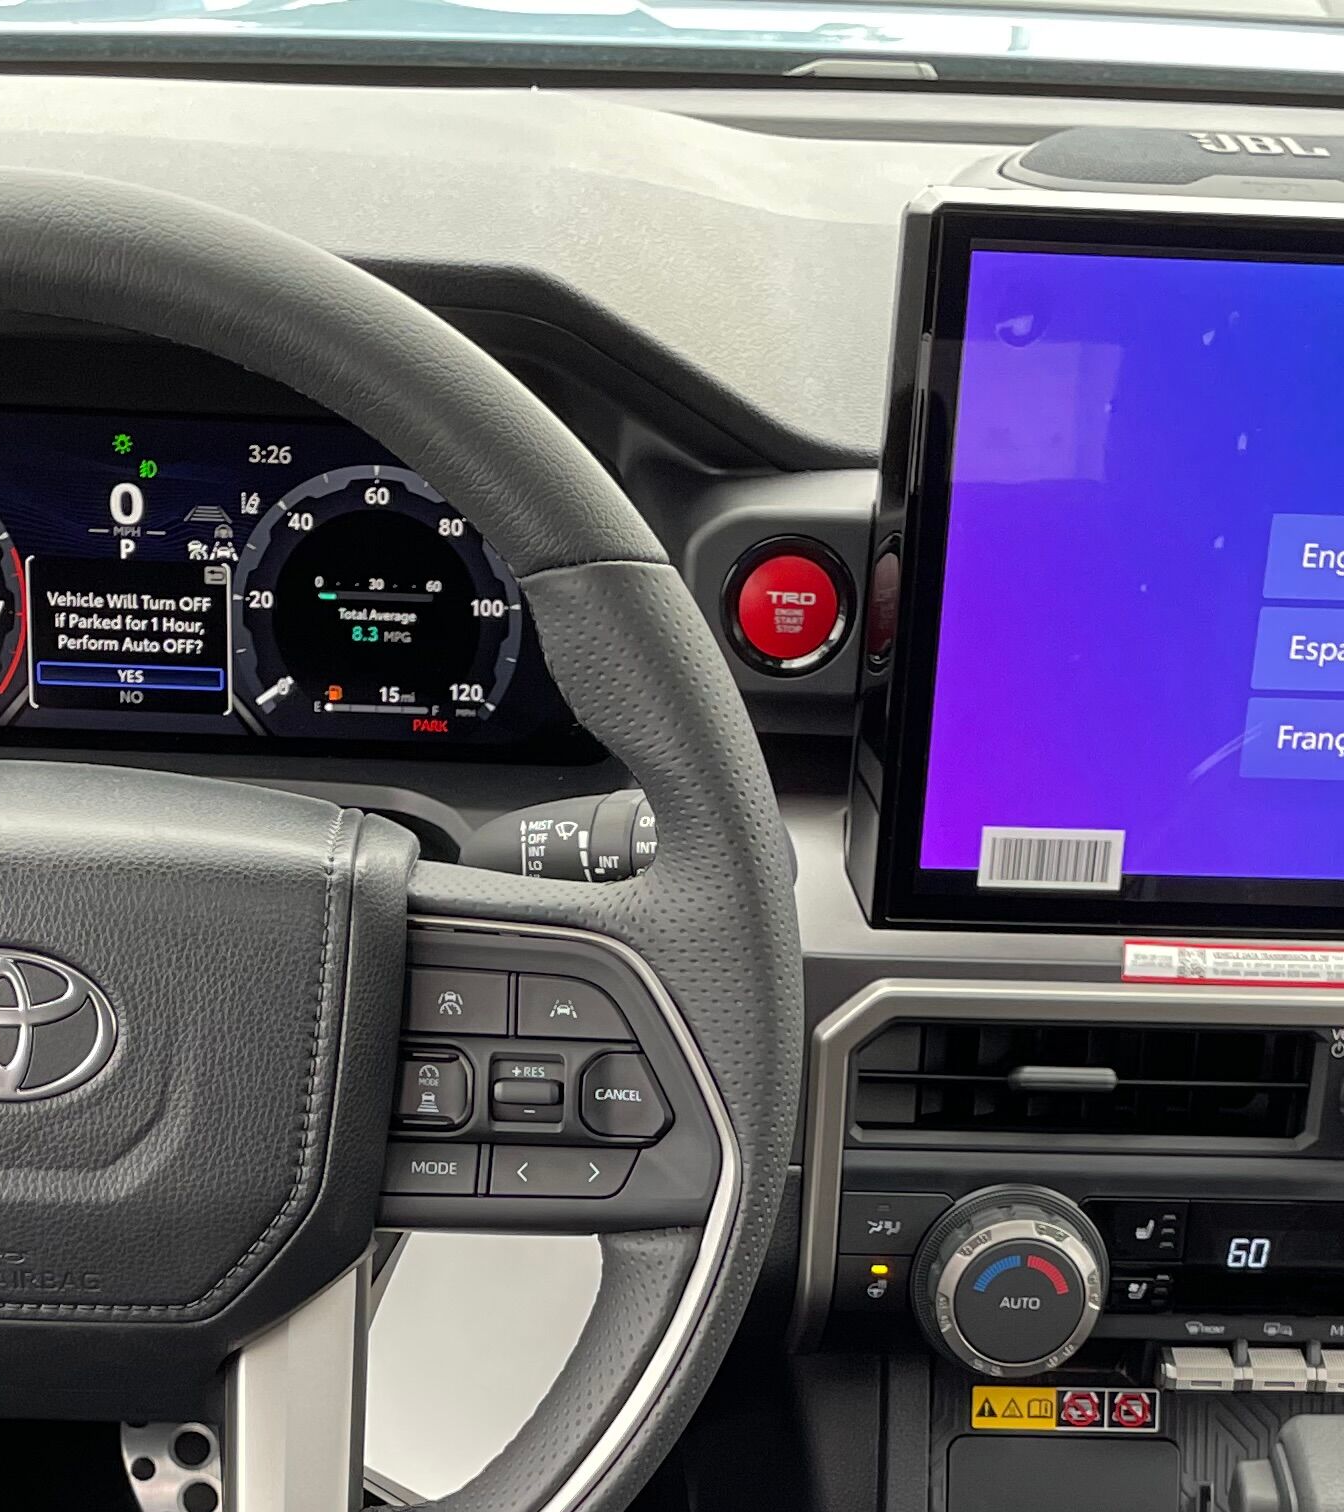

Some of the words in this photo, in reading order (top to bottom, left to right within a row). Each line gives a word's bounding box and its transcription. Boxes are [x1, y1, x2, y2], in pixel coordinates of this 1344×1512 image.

[1186, 131, 1331, 159] JBL
[248, 444, 292, 464] 3:26
[365, 487, 390, 505] 60
[109, 482, 144, 525] 0
[289, 513, 314, 531] 40
[438, 519, 464, 537] 80
[113, 526, 141, 538] MPH
[120, 538, 135, 559] P
[314, 576, 324, 588] 0
[368, 578, 385, 590] 30
[426, 580, 442, 593] 60
[47, 591, 104, 609] Vehicle
[106, 593, 138, 609] Will
[140, 595, 176, 611] Turn
[178, 597, 211, 613] OFF
[248, 590, 274, 609] 20
[766, 591, 816, 605] TRD
[471, 599, 504, 617] 100
[775, 608, 804, 616] ENGINE
[338, 607, 368, 621] Total
[369, 609, 417, 624] Average
[775, 616, 804, 625] START
[55, 613, 66, 628] if
[68, 614, 122, 631] Parked
[125, 615, 148, 631] for
[151, 617, 158, 631] 1
[162, 618, 205, 635] Hour,
[775, 625, 803, 633] STOP
[352, 626, 379, 642] 8.3
[384, 631, 411, 643] MPG
[58, 634, 118, 652] Perform
[121, 636, 160, 653] Auto
[163, 637, 204, 654] OFF?
[117, 669, 144, 683] YES
[120, 691, 144, 704] NO
[449, 684, 483, 701] 120
[313, 701, 322, 713] E
[432, 705, 440, 717] F
[413, 720, 448, 732] PARK
[528, 819, 554, 830] MIST
[528, 833, 548, 844] OFF
[529, 846, 545, 857] INT
[636, 841, 657, 854] INT
[528, 861, 542, 871] LO
[598, 856, 619, 869] INT
[418, 1078, 439, 1087] MODE
[594, 1088, 642, 1102] CANCEL
[411, 1161, 457, 1175] MODE
[1227, 1238, 1270, 1269] 60
[999, 1296, 1041, 1310] AUTO
[1200, 1325, 1225, 1335] FRONT
